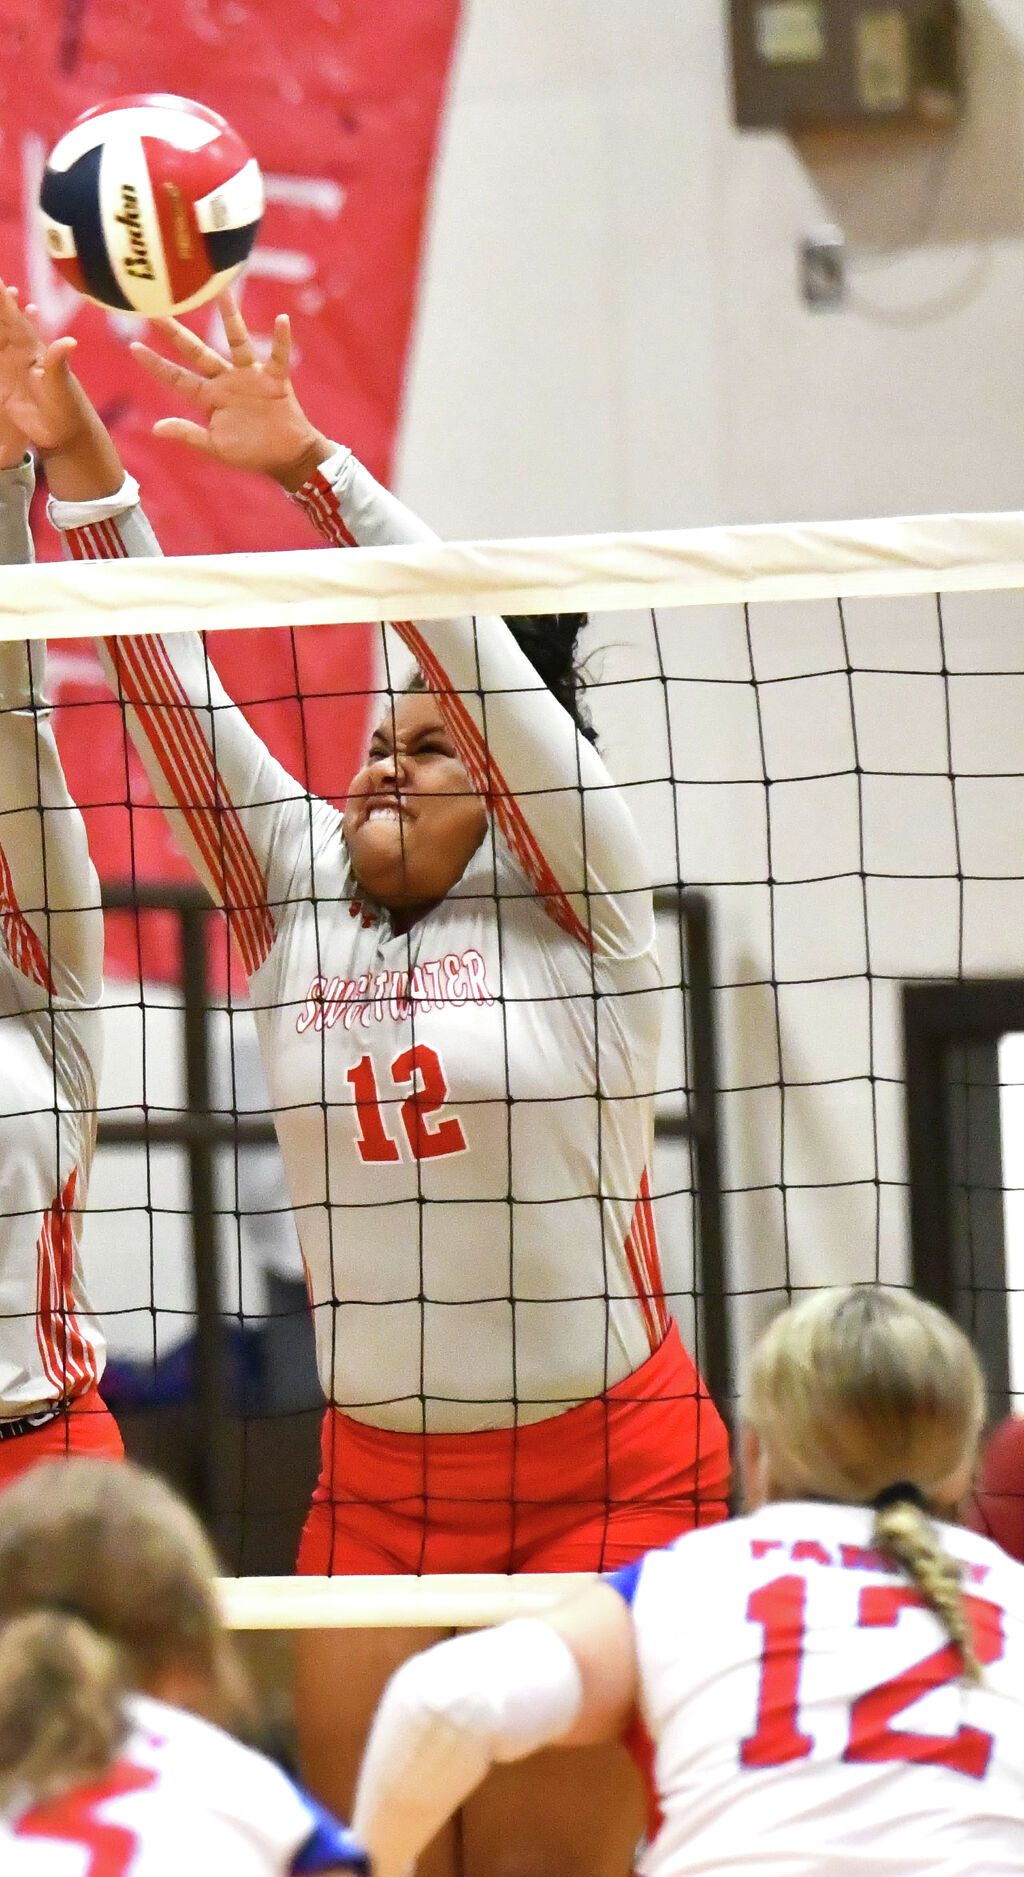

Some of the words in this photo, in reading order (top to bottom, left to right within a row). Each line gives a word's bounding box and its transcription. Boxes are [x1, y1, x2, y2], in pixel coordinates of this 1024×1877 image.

[113, 183, 156, 282] Baden
[346, 1043, 468, 1163] 12
[739, 1573, 1007, 1781] 12
